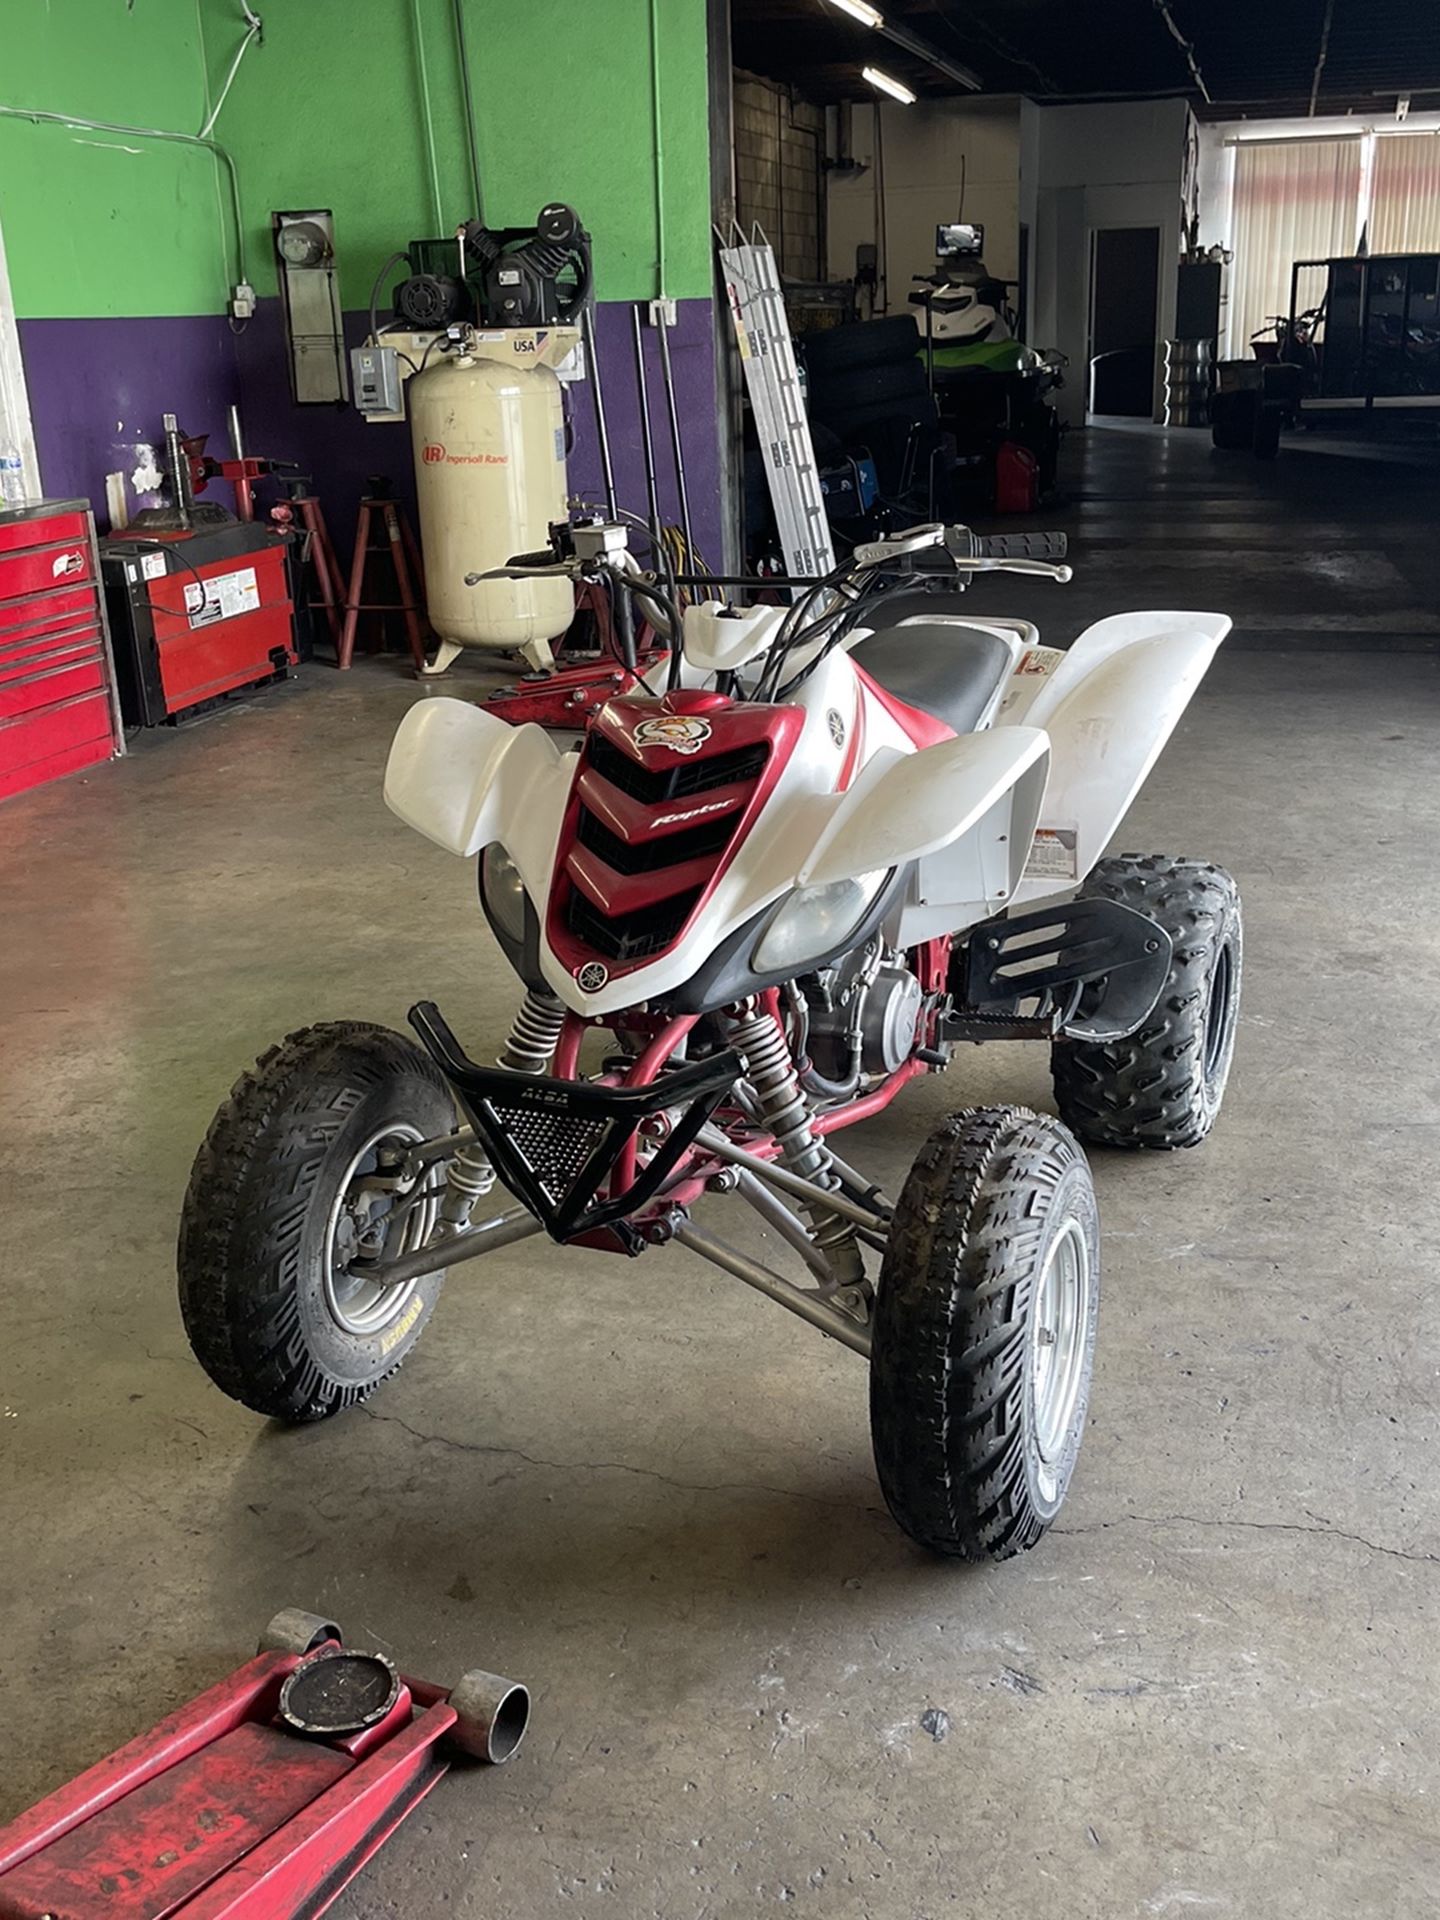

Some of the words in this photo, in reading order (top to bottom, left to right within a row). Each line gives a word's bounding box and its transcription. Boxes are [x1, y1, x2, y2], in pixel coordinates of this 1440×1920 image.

[513, 340, 535, 352] USA
[424, 445, 443, 463] IR
[447, 454, 483, 465] Ingersoll
[649, 798, 736, 830] Raptor
